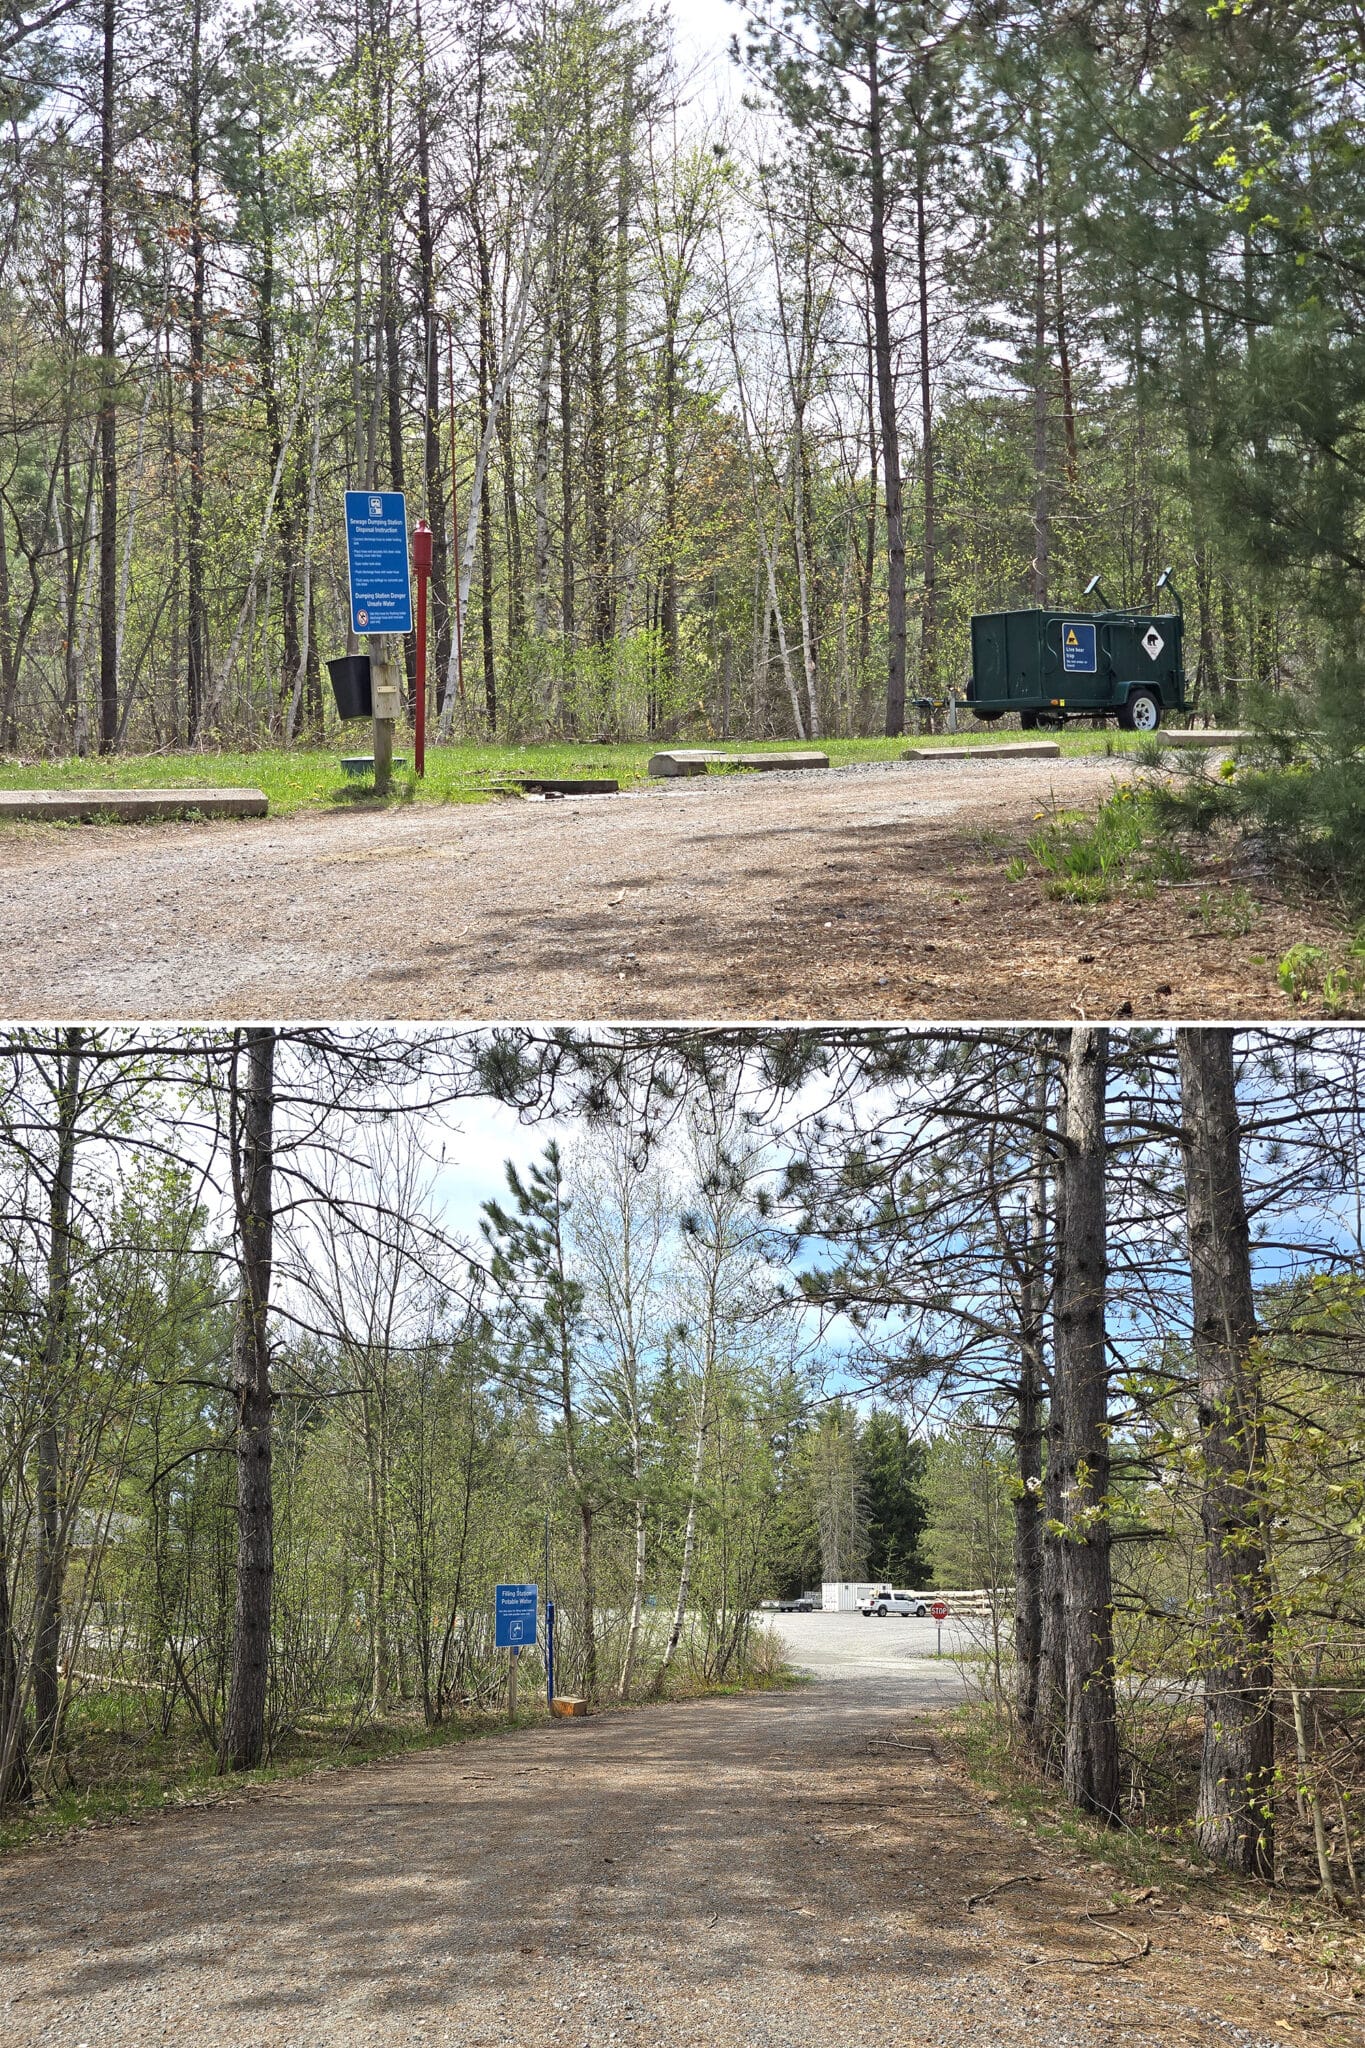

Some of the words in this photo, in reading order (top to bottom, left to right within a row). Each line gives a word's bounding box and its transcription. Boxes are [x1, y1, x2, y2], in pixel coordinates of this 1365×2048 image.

[350, 518, 367, 526] Sewage
[356, 526, 374, 534] Disposal
[355, 592, 374, 600] Dumping
[390, 592, 406, 600] Danger
[931, 1607, 947, 1615] STOP
